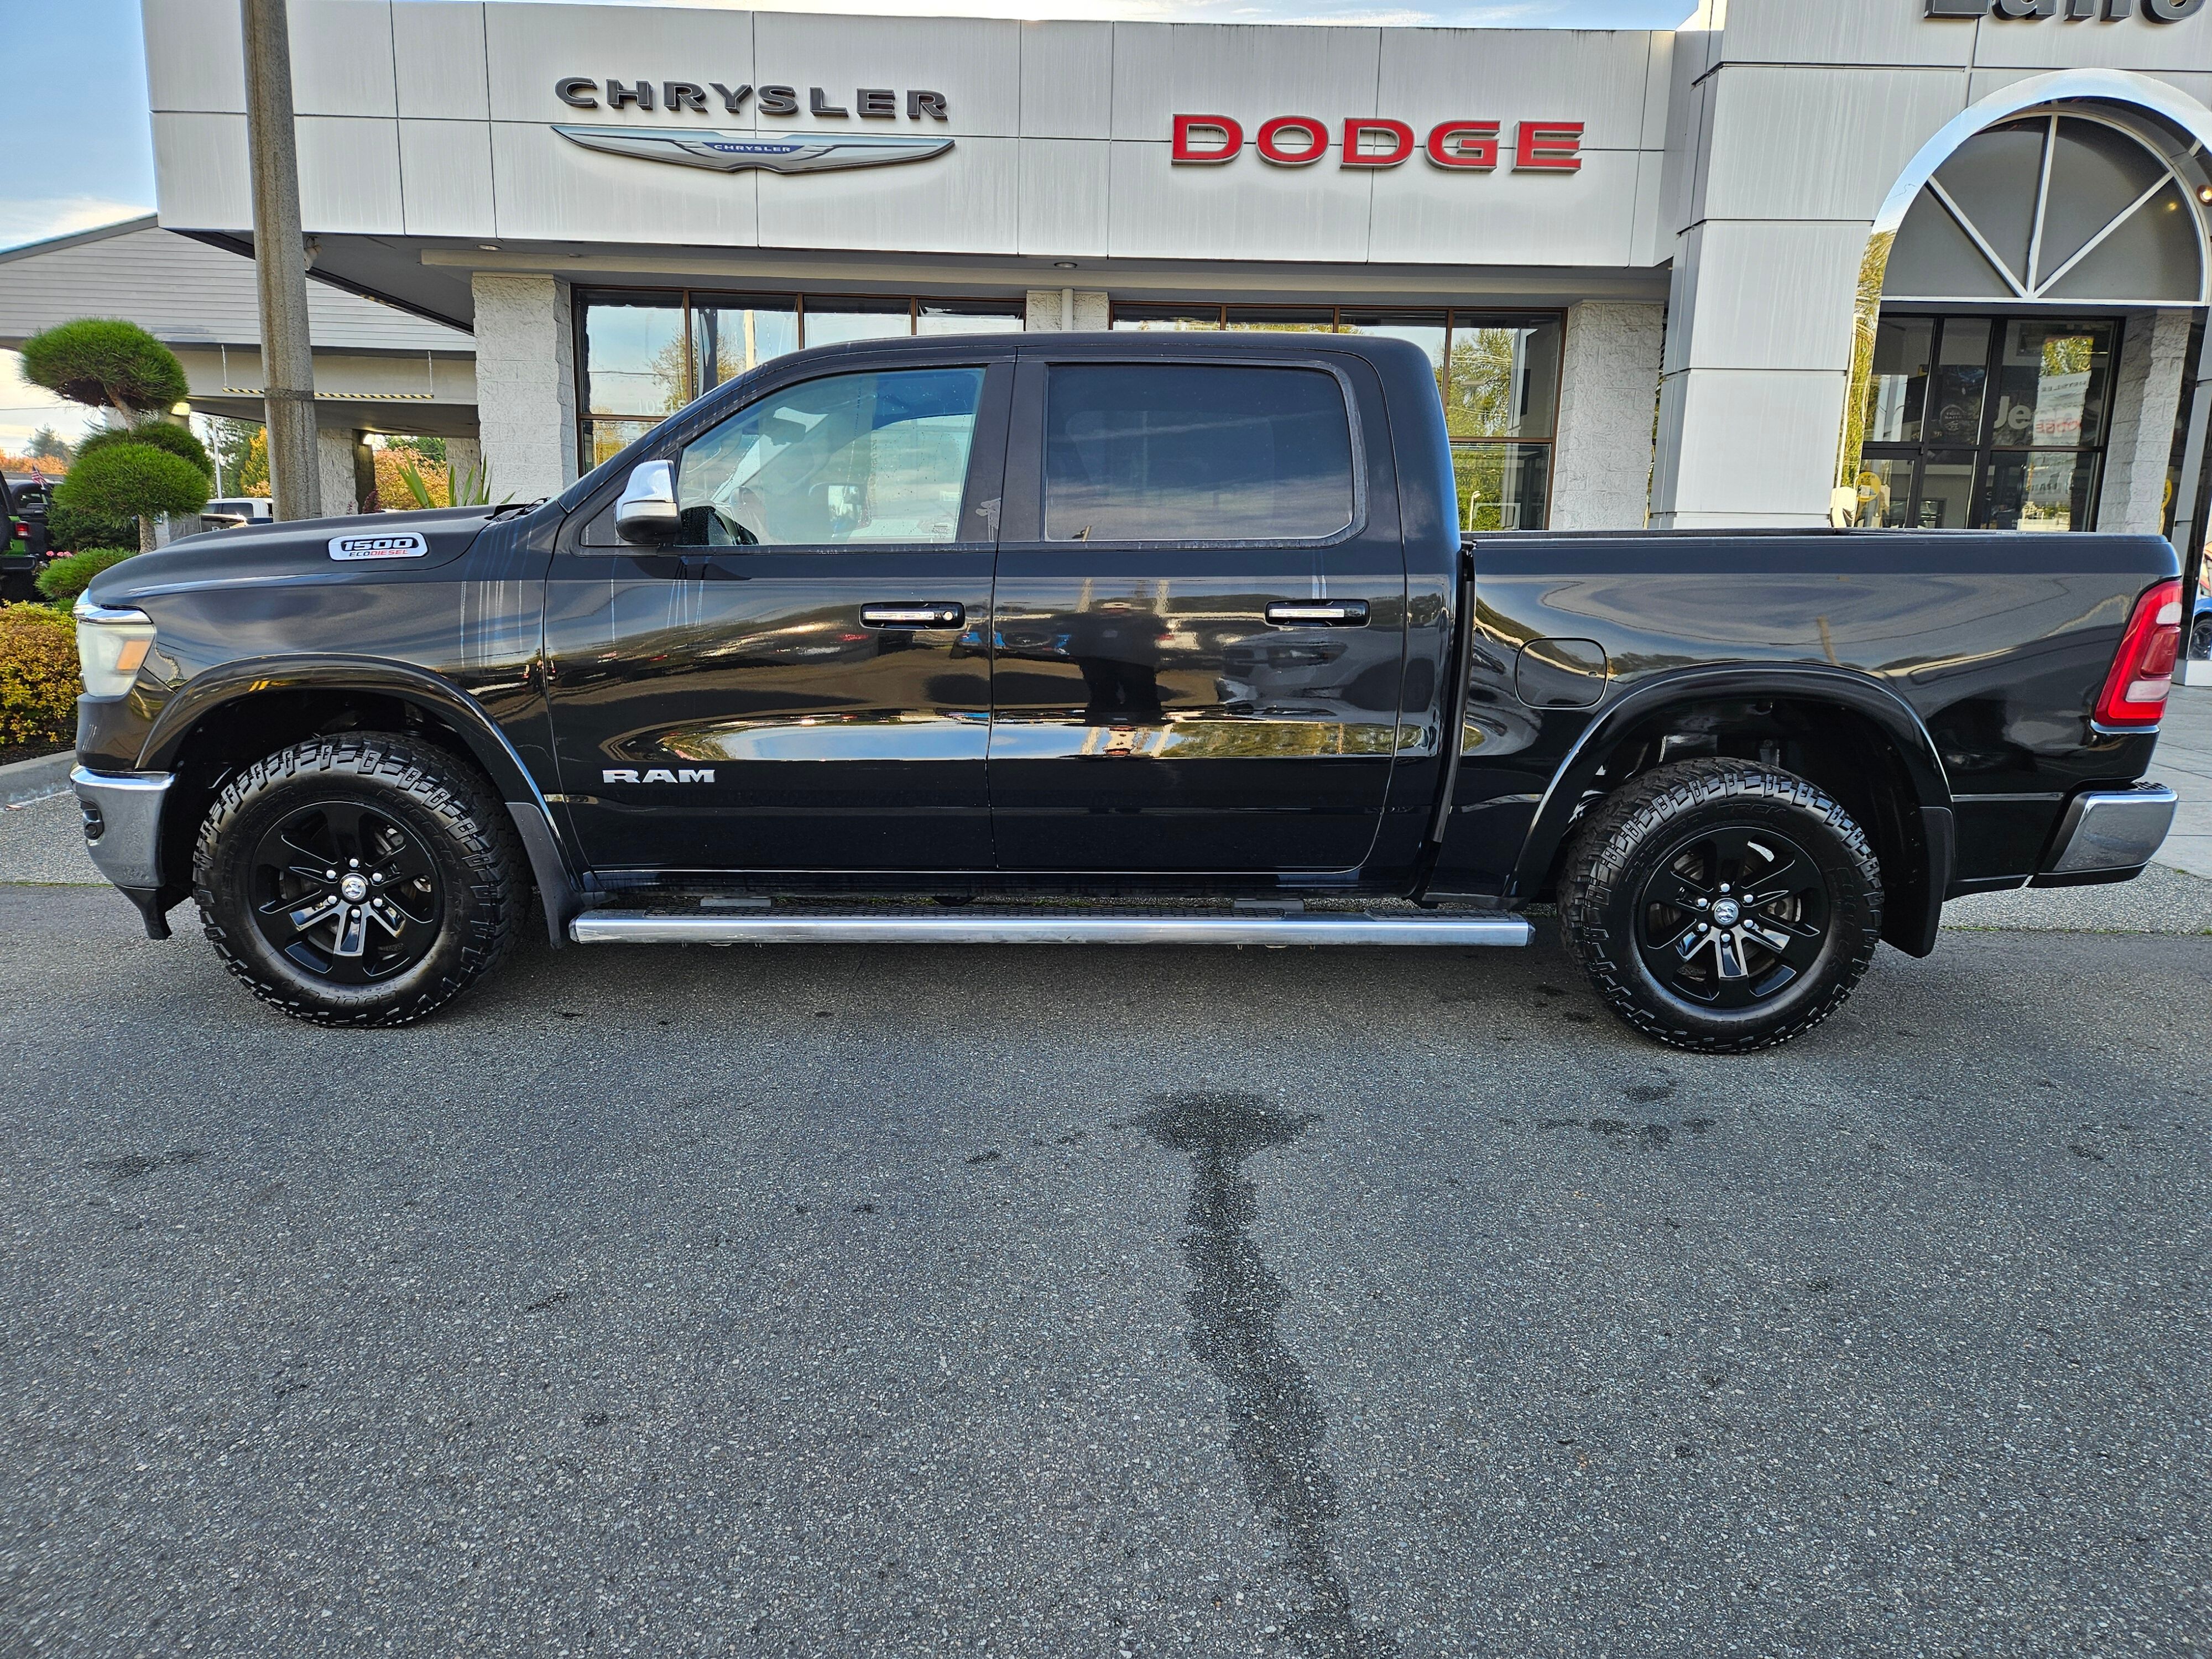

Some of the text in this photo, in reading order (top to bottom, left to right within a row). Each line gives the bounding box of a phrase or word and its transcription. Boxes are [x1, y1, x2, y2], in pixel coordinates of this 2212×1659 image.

[555, 76, 948, 120] CHRYSLER
[1171, 113, 1585, 173] DODGE
[343, 538, 414, 551] 1500
[602, 769, 716, 784] RAM
